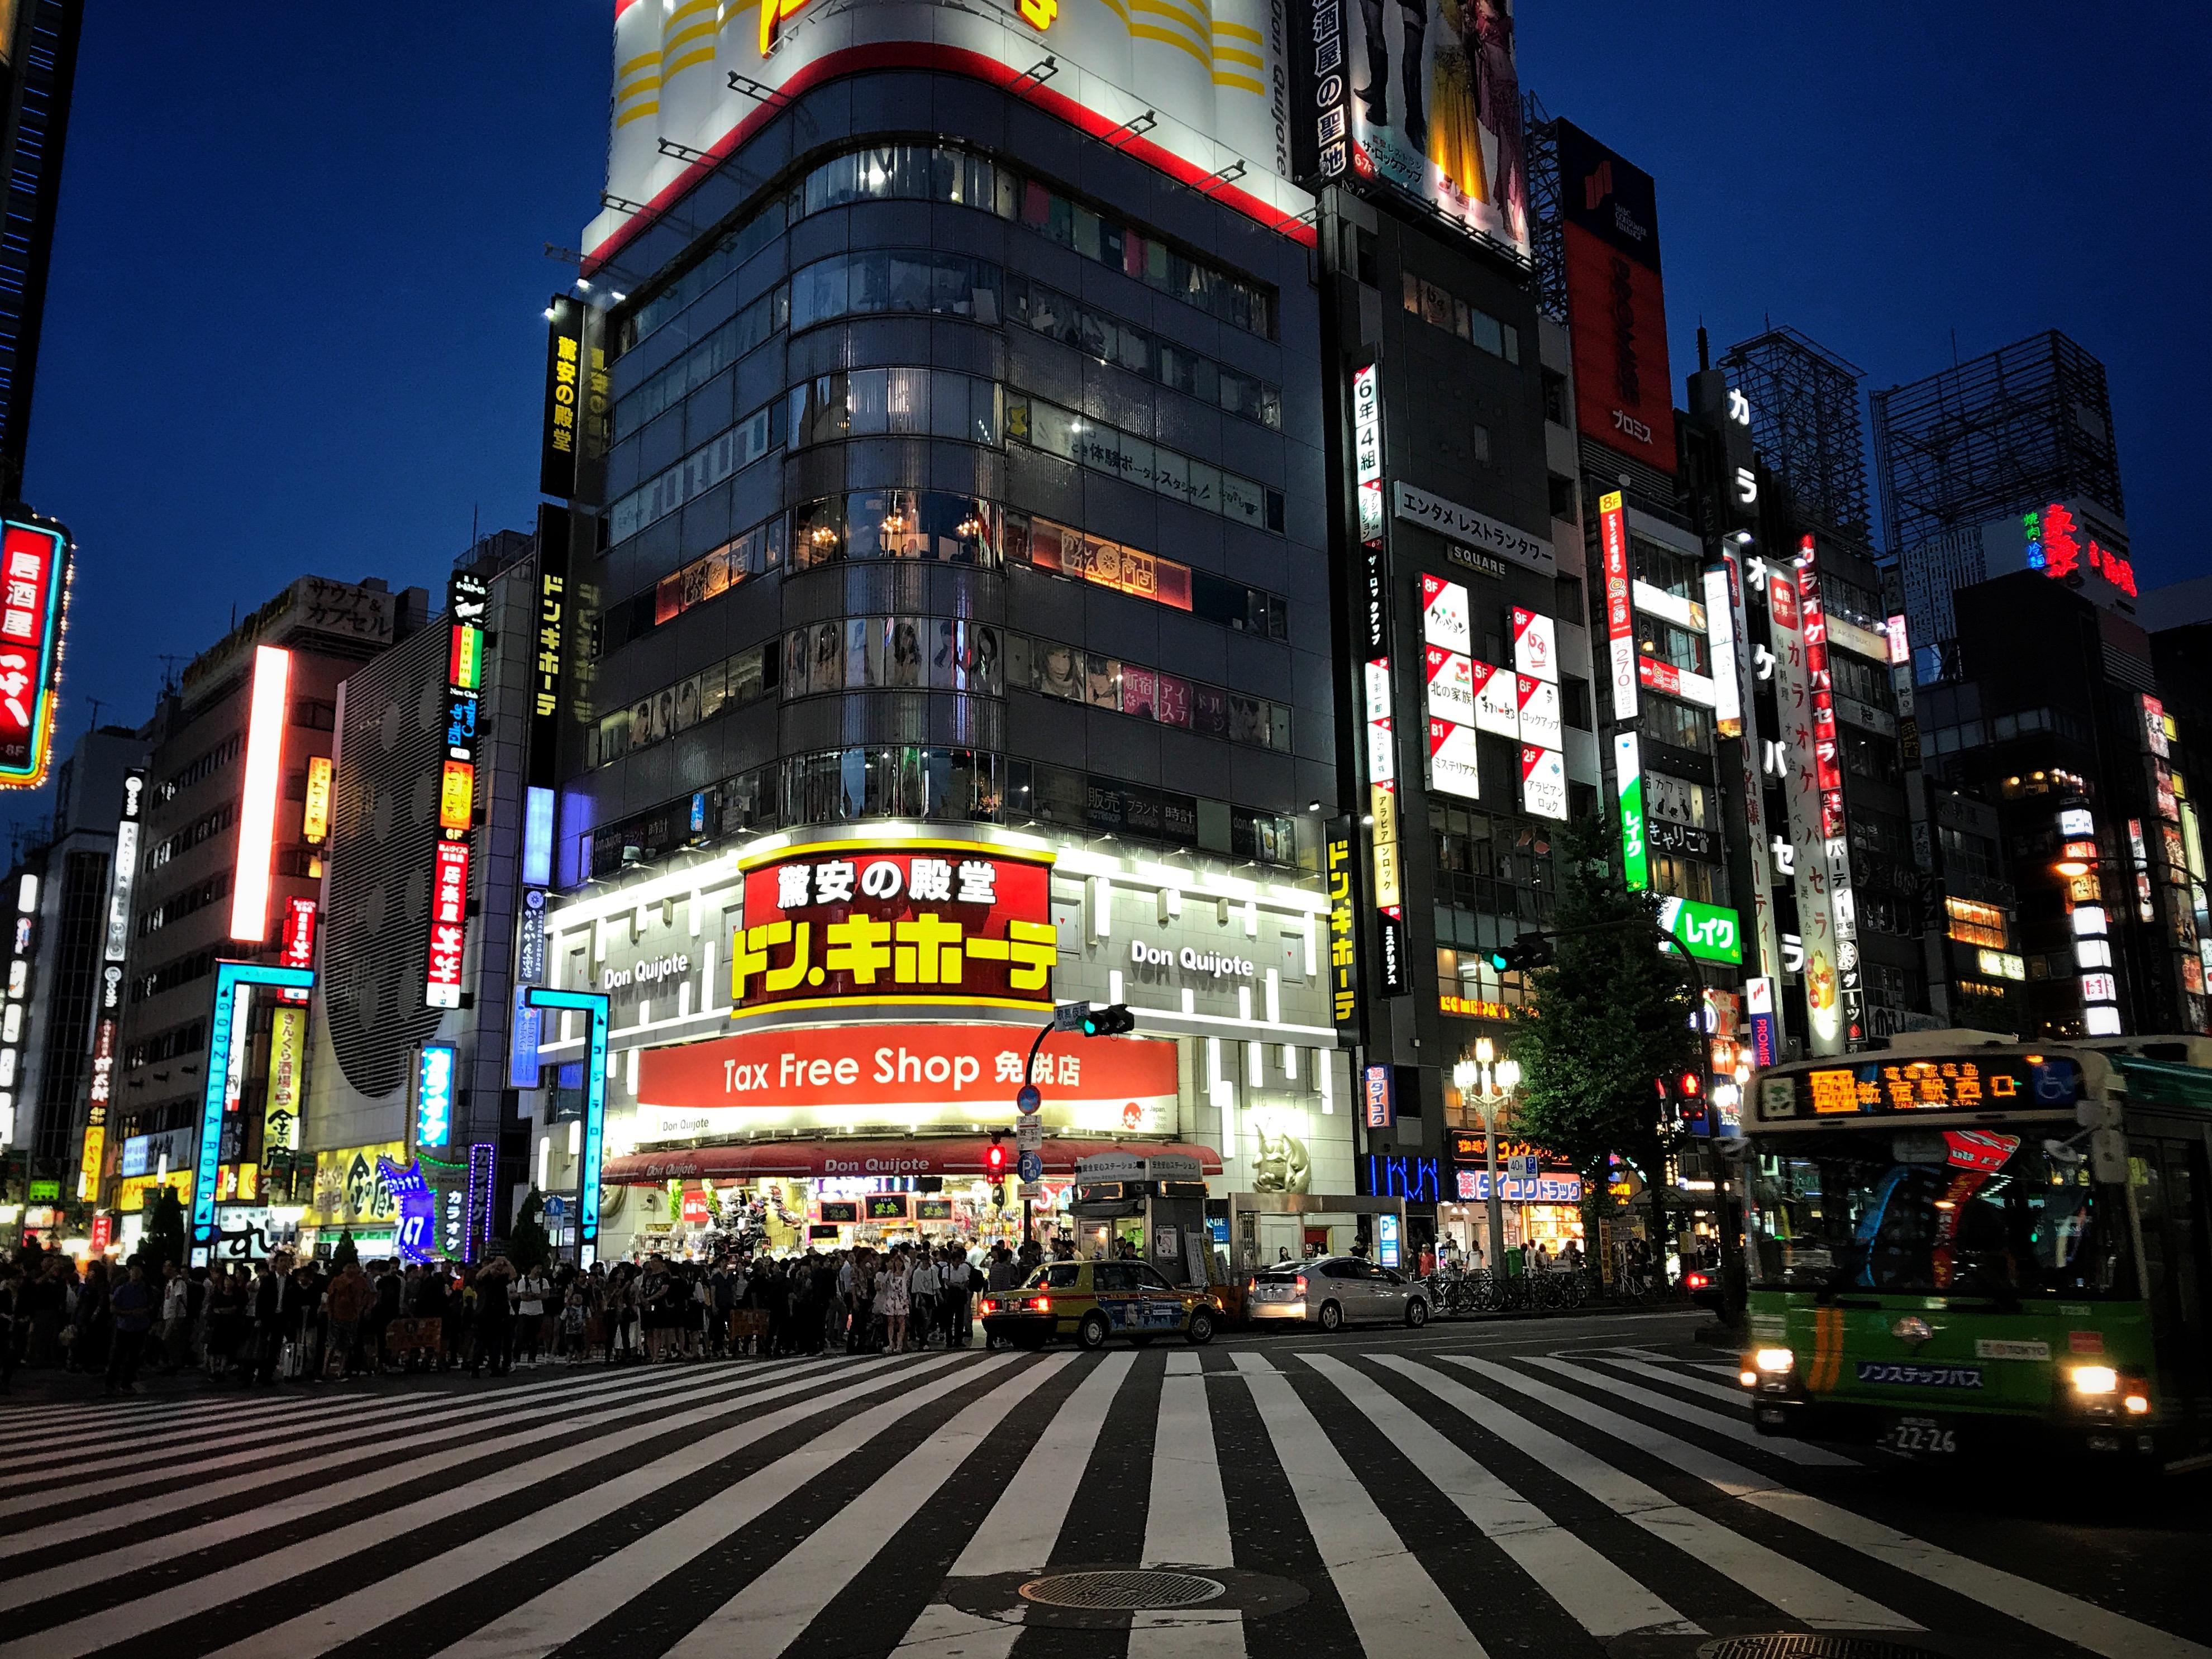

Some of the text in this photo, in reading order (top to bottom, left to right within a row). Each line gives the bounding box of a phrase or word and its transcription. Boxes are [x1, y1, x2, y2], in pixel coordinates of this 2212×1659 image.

[1313, 0, 1346, 177] 酒屋の聖地
[1271, 65, 1286, 177] Quijote
[1615, 212, 1648, 237] CONSUMER
[552, 336, 578, 454] 驚安の殿堂
[1358, 378, 1377, 470] 6年4組
[1612, 409, 1653, 445] プロミス
[1603, 496, 1618, 509] 8F
[2023, 511, 2042, 537] 焼肉
[1453, 545, 1507, 575] SQUARE
[2, 551, 40, 638] 居酒屋
[1425, 579, 1438, 593] 8F
[1515, 612, 1527, 624] 9F
[1837, 628, 1872, 648] AKATSUKI
[1428, 651, 1442, 665] 4F
[1475, 666, 1488, 679] 5F
[450, 687, 479, 699] New Club
[1124, 671, 1153, 697] 新宿
[1431, 680, 1473, 706] 北の家族
[1519, 679, 1532, 693] 6F
[447, 703, 463, 746] Elle de
[461, 699, 476, 737] Castle
[1431, 723, 1443, 737] B1
[1522, 711, 1560, 731] ロックアップ
[1434, 756, 1477, 778] ミステリアス
[1524, 749, 1536, 763] 2F
[1527, 779, 1565, 798] アラビアン
[1088, 786, 1196, 824] 販売 ブランド 時計
[1538, 798, 1558, 813] ロック
[446, 828, 463, 840] 6F
[1378, 795, 1391, 890] アラビアンロック
[1625, 810, 1642, 858] レイク
[1648, 820, 1699, 852] きゃりこ
[776, 857, 998, 909] 驚安の殿堂
[1828, 840, 1847, 919] パーティー
[1685, 912, 1734, 948] レイク
[604, 952, 688, 989] Don Quijote
[1131, 939, 1254, 980] Don Quijote
[1385, 926, 1397, 985] ミステリアス
[1841, 970, 1861, 1021] ダーツ
[1756, 1018, 1771, 1067] PROMISE
[724, 1046, 1082, 1094] Tax Free Shop 免税店
[199, 1002, 231, 1200] GODZILLA ROAD
[422, 1047, 451, 1144] カラオケ
[1368, 1066, 1386, 1127] 薬 ダイコク
[1856, 1075, 2016, 1104] 新宿駅西口
[662, 1117, 710, 1133] Don Quijote
[646, 1161, 698, 1177] Don Quijote
[824, 1156, 931, 1174] Don Quijote
[472, 1150, 490, 1222] カラオケ
[1457, 1171, 1476, 1199] 薬
[394, 1215, 425, 1246] 747
[445, 1190, 463, 1252] カラオケ
[1858, 1364, 1984, 1388] ノンステップバス
